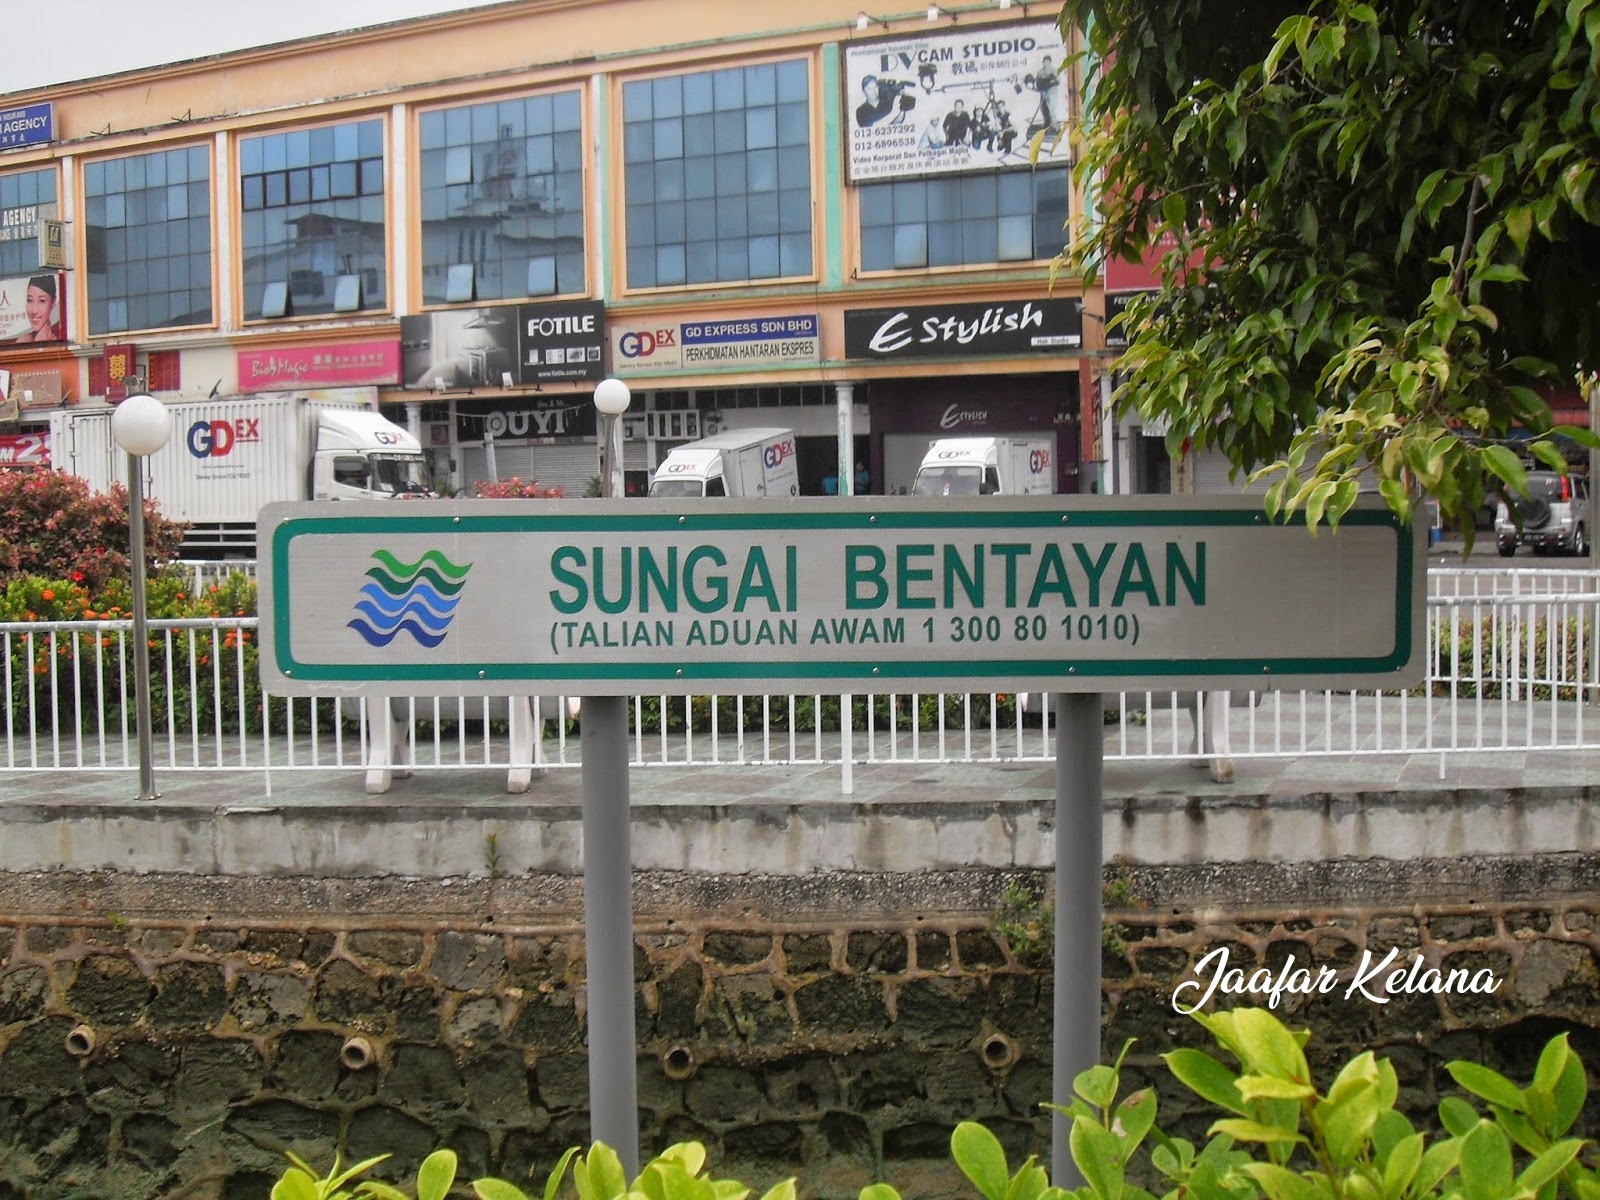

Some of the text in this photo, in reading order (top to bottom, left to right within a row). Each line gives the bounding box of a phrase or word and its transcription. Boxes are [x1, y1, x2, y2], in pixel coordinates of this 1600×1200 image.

[963, 37, 1036, 59] STUDIO
[4, 116, 47, 133] AGENCY
[873, 153, 902, 163] Korporat
[3, 207, 36, 226] AGENCY
[527, 315, 595, 337] FOTILE
[686, 319, 812, 338] GD EXPRESS SDN BHD
[686, 341, 814, 362] PERKHIDMATAN HANTARAN EKSPRES
[549, 541, 1207, 614] SUNGAI BENTAYAN
[550, 613, 1140, 655] (TALIAN ADUAN AWAM 1 300 80 1010)
